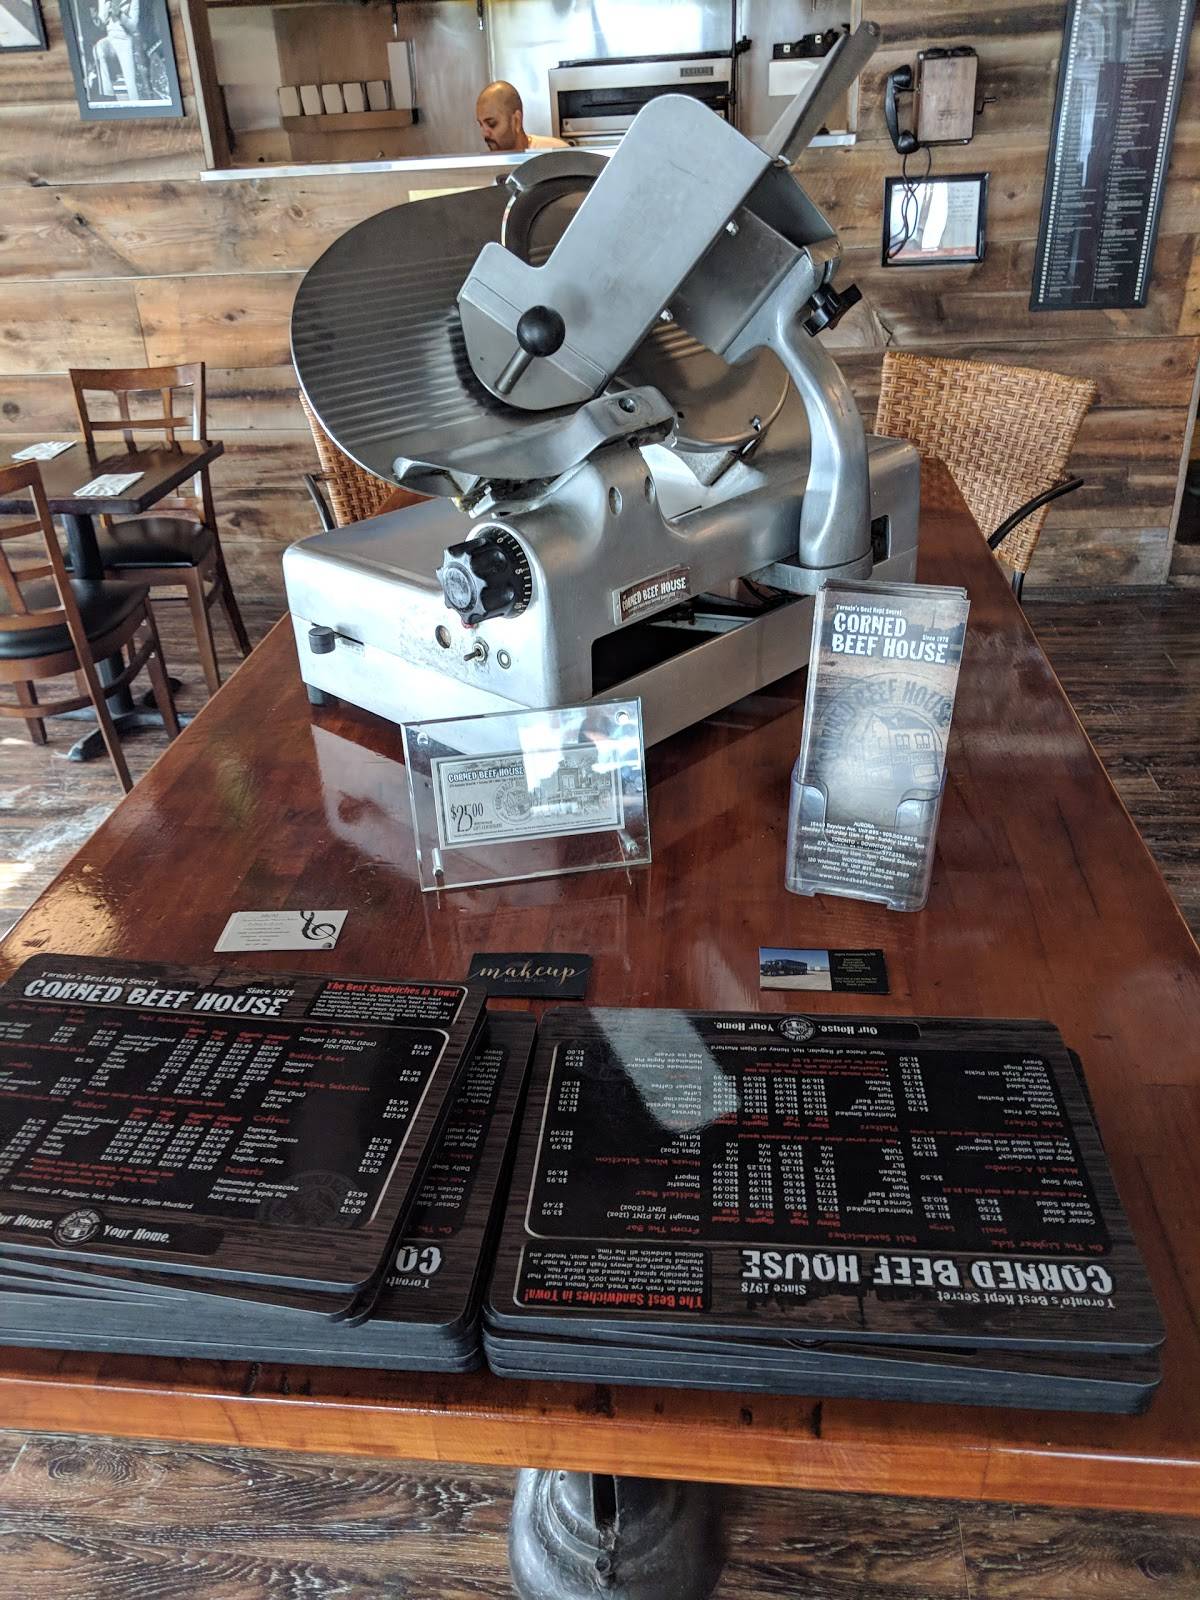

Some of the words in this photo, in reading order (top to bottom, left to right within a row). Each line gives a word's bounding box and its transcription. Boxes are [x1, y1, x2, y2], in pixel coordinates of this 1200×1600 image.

[643, 585, 658, 600] BEEF
[661, 577, 686, 594] HOUSE
[834, 613, 907, 637] CORNED
[832, 634, 878, 656] BEEF
[883, 638, 948, 663] HOUSE
[448, 771, 477, 783] CORNED
[479, 769, 497, 779] BEEF
[500, 767, 524, 777] HOUSE
[480, 960, 575, 985] makeup
[41, 972, 82, 980] Toronto's
[106, 976, 126, 985] Kept
[129, 978, 158, 987] Secret
[326, 982, 344, 990] The
[346, 983, 366, 992] Best
[369, 984, 421, 996] Sandwiches
[433, 989, 459, 998] Town!
[24, 979, 123, 1002] CORNED
[126, 988, 195, 1009] BEEF
[193, 992, 289, 1016] HOUSE
[713, 1021, 746, 1031] Home.
[748, 1022, 774, 1032] Your
[818, 1025, 855, 1035] House.
[857, 1026, 877, 1035] Our
[247, 1126, 277, 1134] Espresso
[243, 1133, 267, 1141] Double
[268, 1135, 299, 1143] Espresso
[239, 1140, 278, 1149] Cappuccino
[230, 1154, 258, 1163] Regular
[259, 1157, 284, 1165] Coffee
[257, 1182, 299, 1192] Cheesecake
[1041, 1177, 1060, 1185] Soup
[1063, 1179, 1083, 1187] Daily
[238, 1196, 261, 1204] cream
[606, 1210, 629, 1218] (12oz)
[670, 1213, 699, 1221] Draught
[13, 1215, 53, 1229] House.
[103, 1225, 133, 1239] Your
[133, 1228, 170, 1243] Home.
[742, 1250, 859, 1283] HOUSE
[873, 1255, 960, 1286] BEEF
[971, 1261, 1112, 1293] CORNED
[741, 1282, 770, 1293] 1978
[773, 1284, 807, 1295] Since
[524, 1288, 558, 1302] Town!
[562, 1290, 573, 1302] in
[576, 1291, 644, 1306] Sandwiches
[648, 1294, 675, 1308] Best
[936, 1291, 980, 1304] Secret
[982, 1292, 1014, 1305] Kept
[1018, 1295, 1048, 1306] Best
[680, 1296, 704, 1309] The
[1051, 1297, 1115, 1308] Toronto's
